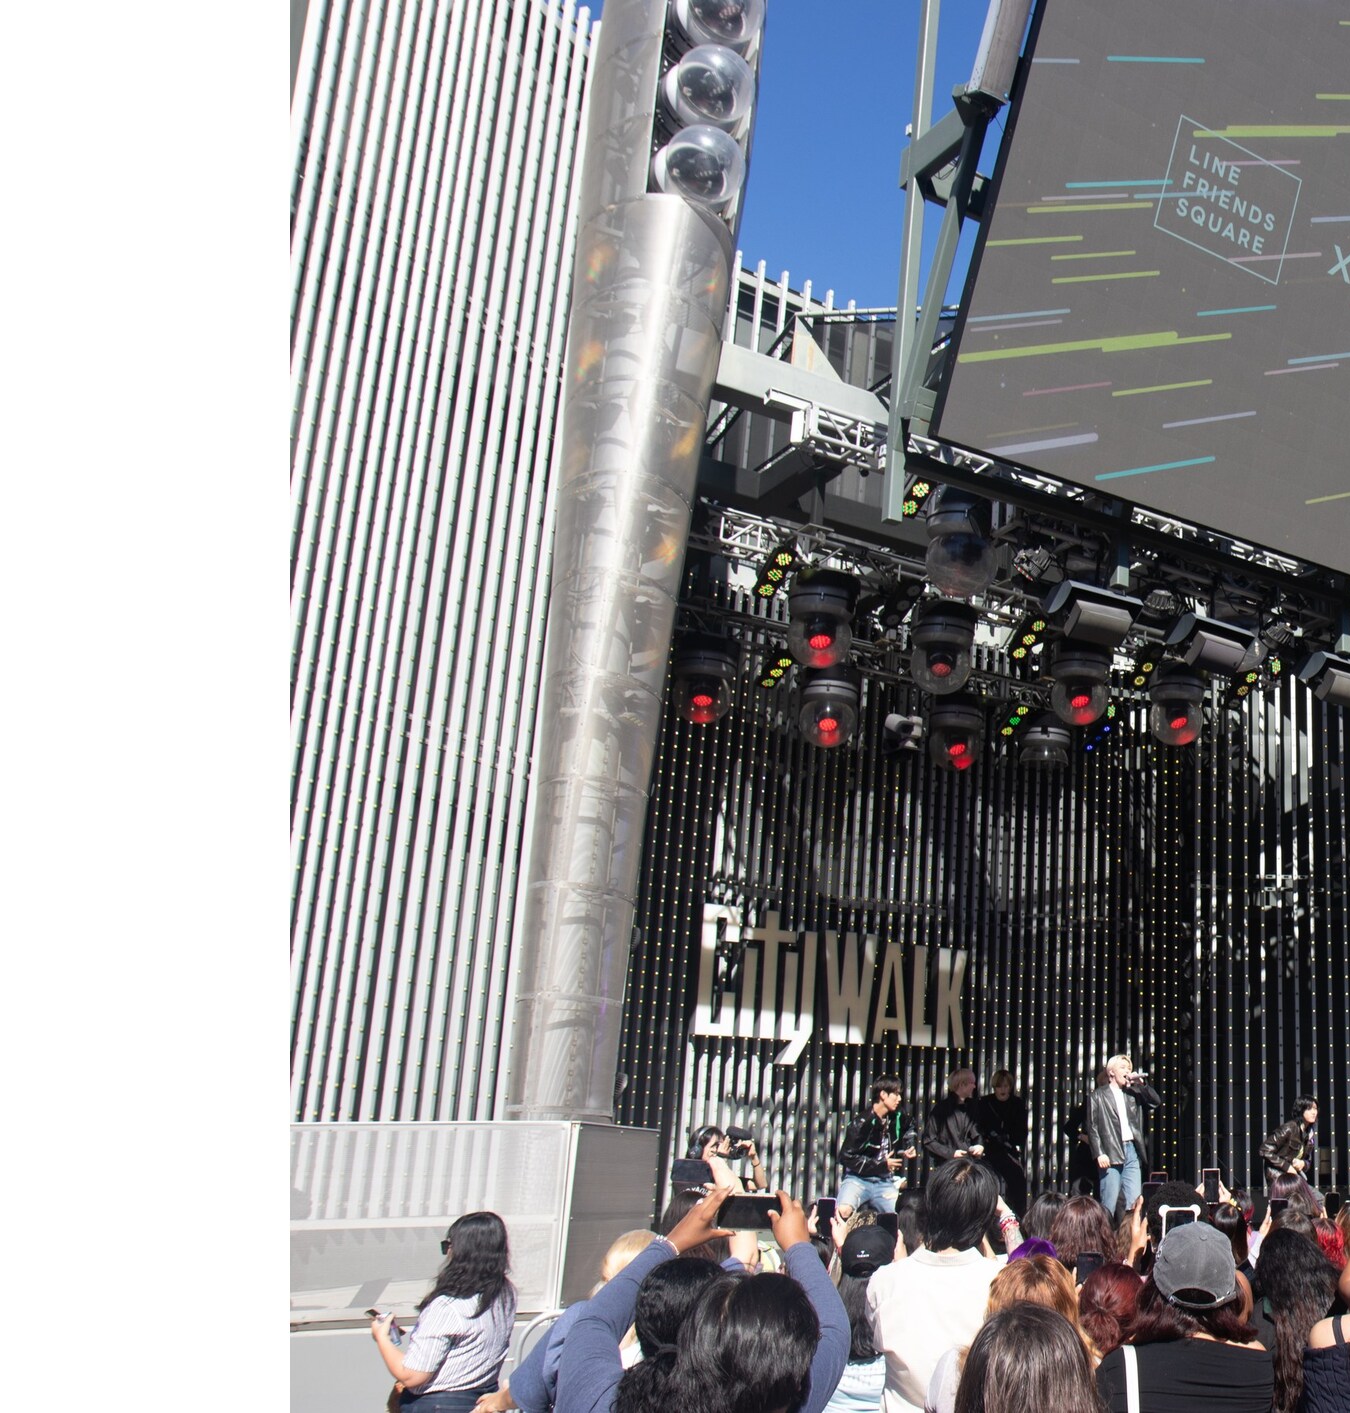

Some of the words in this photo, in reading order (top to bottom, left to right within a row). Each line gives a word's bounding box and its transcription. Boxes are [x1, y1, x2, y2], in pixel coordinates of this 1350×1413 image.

[1189, 144, 1241, 185] LINE
[1176, 198, 1265, 255] SQUARE
[1182, 171, 1276, 231] FRIENDS
